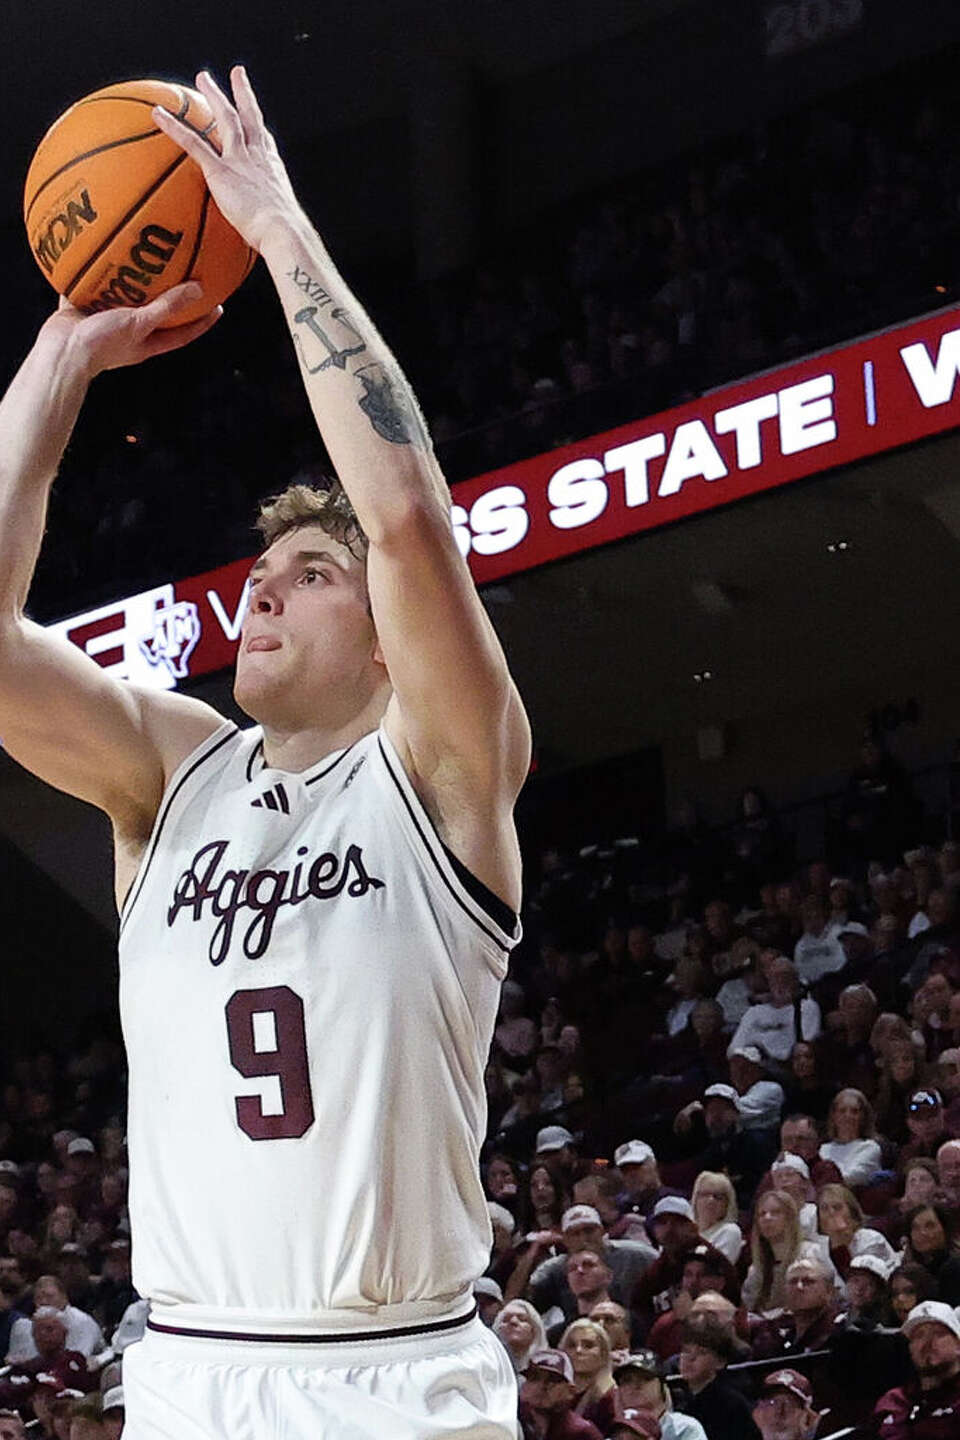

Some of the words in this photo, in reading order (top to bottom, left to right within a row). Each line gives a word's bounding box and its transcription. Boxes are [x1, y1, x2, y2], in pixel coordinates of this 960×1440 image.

[286, 266, 333, 307] XXIII
[547, 374, 837, 530] STATE
[167, 840, 386, 967] Aggies
[225, 985, 316, 1141] 9
